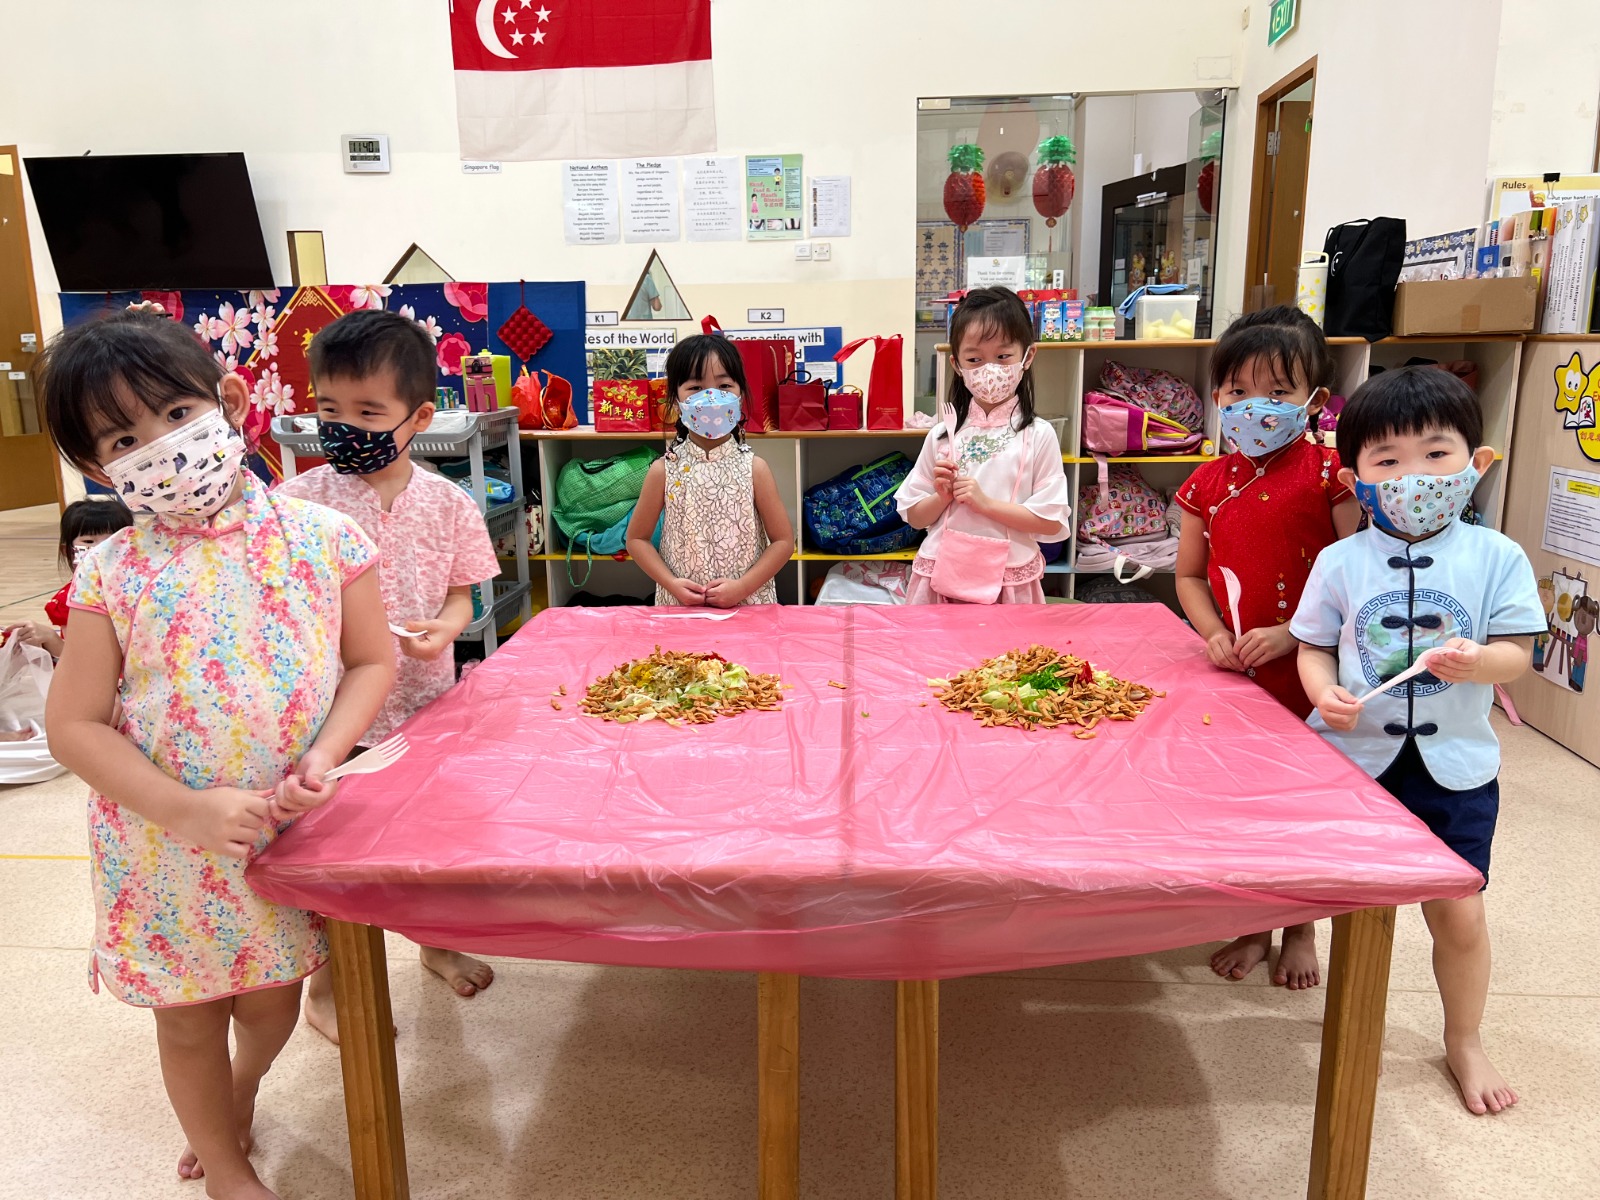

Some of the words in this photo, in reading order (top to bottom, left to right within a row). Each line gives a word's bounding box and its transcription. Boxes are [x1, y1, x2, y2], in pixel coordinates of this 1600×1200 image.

[1502, 181, 1527, 190] Rules
[760, 312, 772, 320] K2
[603, 333, 614, 344] of
[618, 333, 637, 343] the
[639, 333, 674, 343] World
[798, 332, 822, 343] with
[598, 400, 644, 421] 新年快乐
